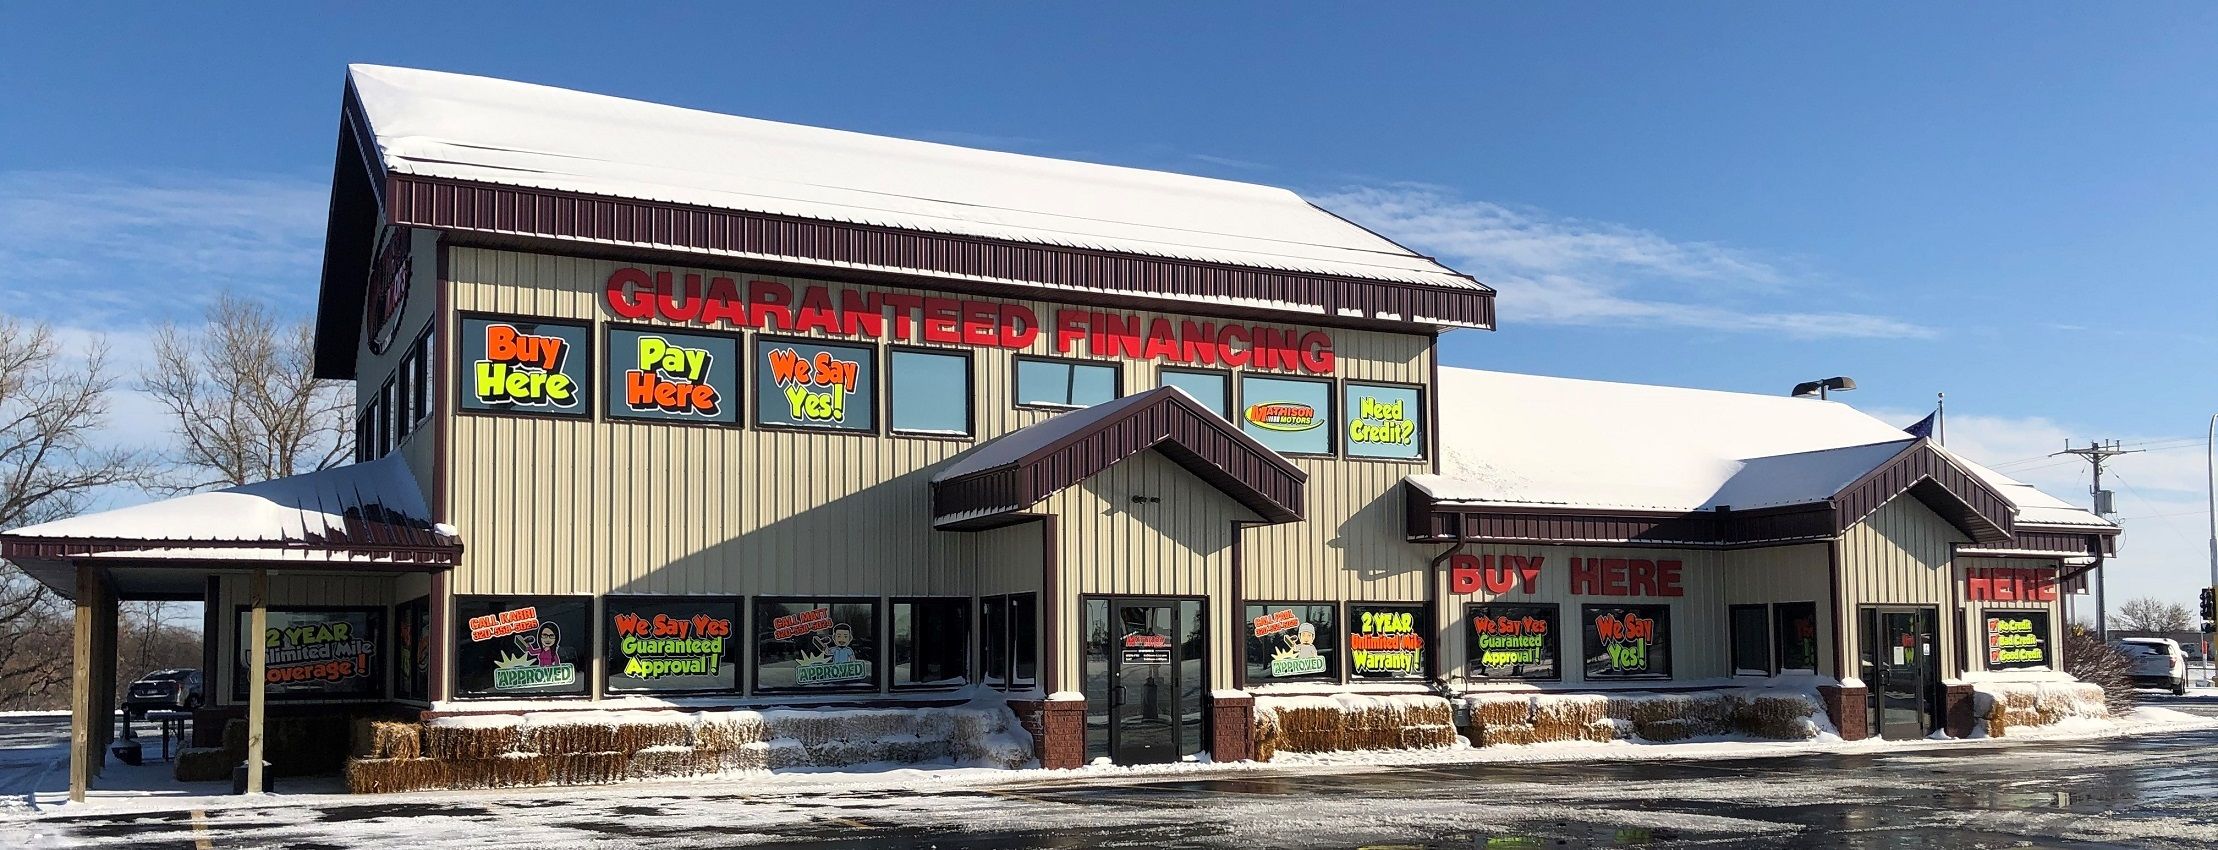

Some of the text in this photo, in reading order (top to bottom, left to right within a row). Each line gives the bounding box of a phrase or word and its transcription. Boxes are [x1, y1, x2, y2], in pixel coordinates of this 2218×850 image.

[606, 267, 1335, 374] GUARANTEED FINANCING
[487, 325, 564, 370] Buy
[638, 336, 709, 381] Pay
[769, 348, 860, 394] We Say
[474, 362, 577, 406] Here
[625, 370, 718, 411] Here
[785, 383, 845, 421] Yes!
[1250, 404, 1314, 422] MATHISON
[1360, 396, 1404, 421] Need
[1279, 415, 1312, 424] MOTORS
[1350, 418, 1415, 445] Credit?
[1450, 554, 1684, 597] BUY HERE
[1966, 567, 2057, 601] HERE
[470, 615, 500, 630] CALL
[615, 614, 731, 640] We Say Yes
[775, 608, 829, 629] CALL MATT
[1362, 612, 1412, 633] 2 YEAR
[1474, 617, 1546, 635] We Say Yes
[1596, 614, 1653, 645] We Say
[2009, 619, 2032, 632] Credit
[286, 622, 350, 646] YEAR
[621, 635, 724, 657] Guaranteed
[1351, 633, 1400, 651] Unlimited
[1479, 634, 1543, 649] Guaranteed
[1999, 634, 2037, 646] Bad Credit
[246, 639, 375, 664] limited Mile
[1608, 639, 1646, 670] Yes!
[1999, 648, 2043, 662] Good Credit
[252, 653, 367, 683] overage!
[498, 667, 572, 688] APPROVED
[798, 664, 863, 682] APPROVED
[1273, 658, 1324, 675] APPROVED
